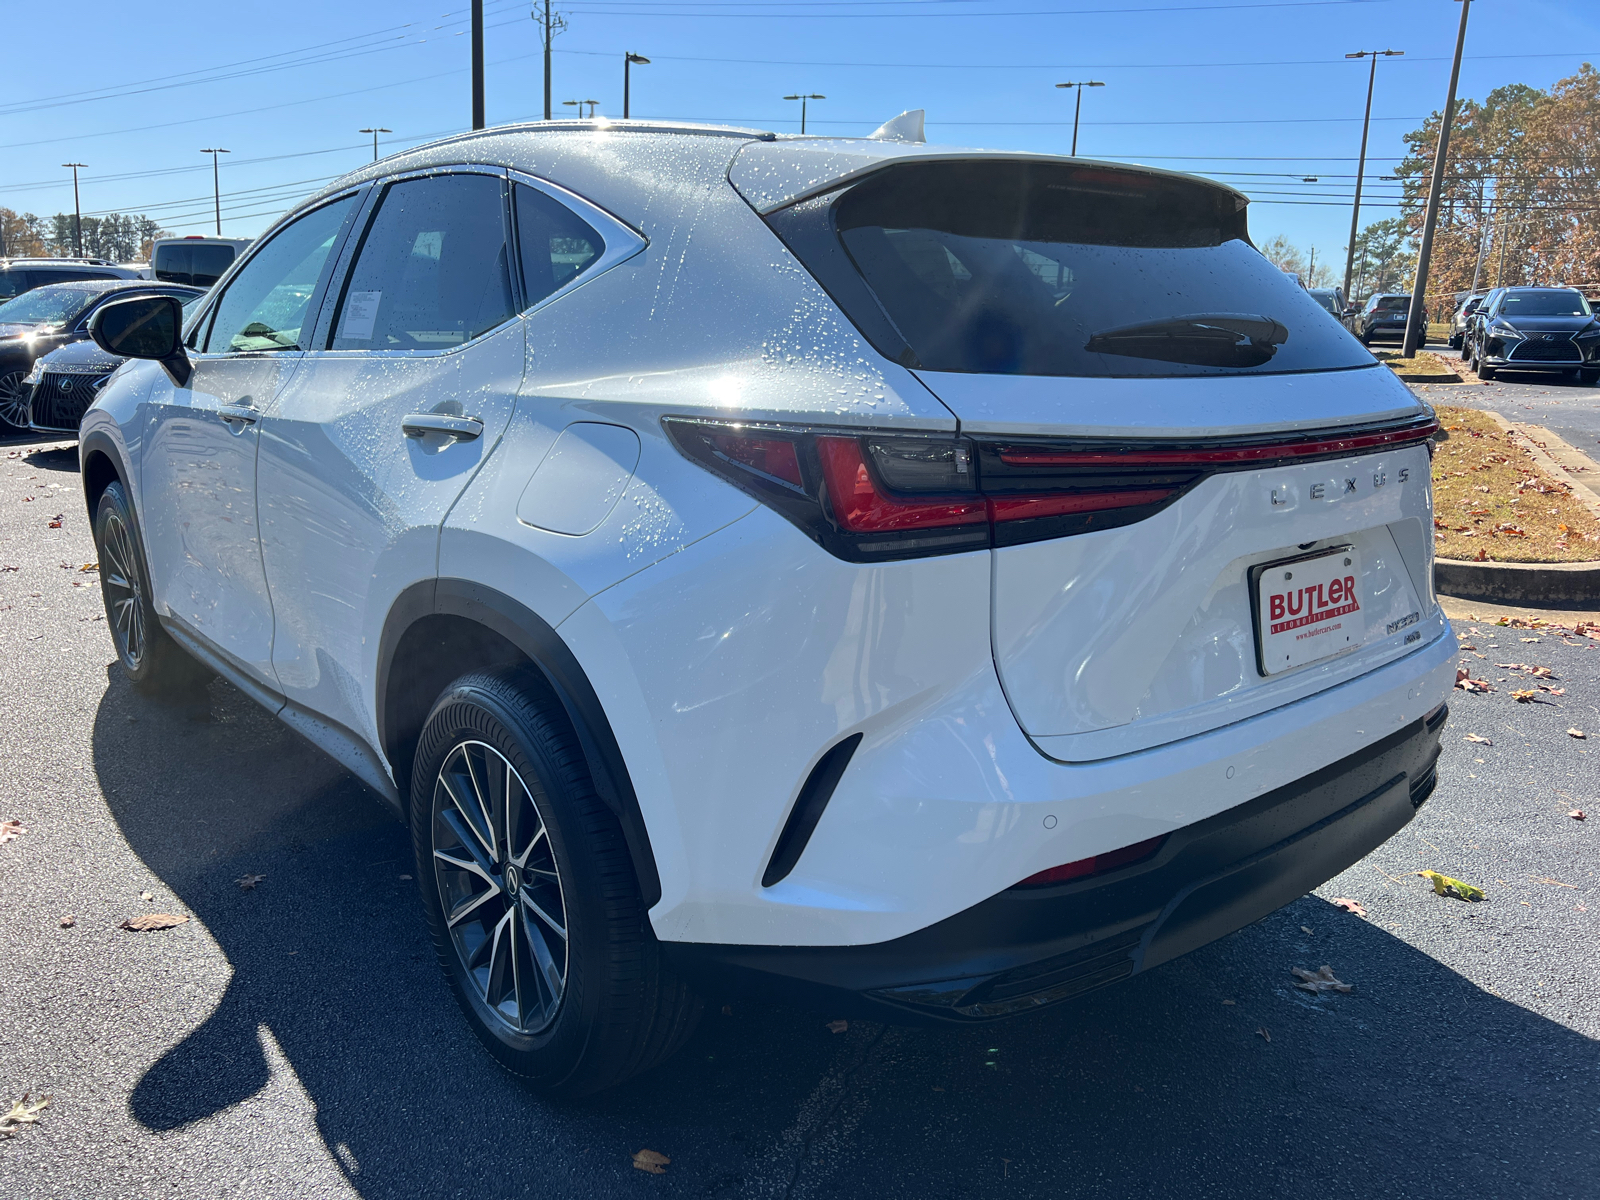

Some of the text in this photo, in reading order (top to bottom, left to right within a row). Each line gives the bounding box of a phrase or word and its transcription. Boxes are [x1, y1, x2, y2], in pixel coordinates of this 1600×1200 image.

[1271, 468, 1409, 505] LEXUS
[1271, 602, 1359, 634] AUTOMOTIVE GROUP
[1295, 622, 1342, 641] www.butlercars.com
